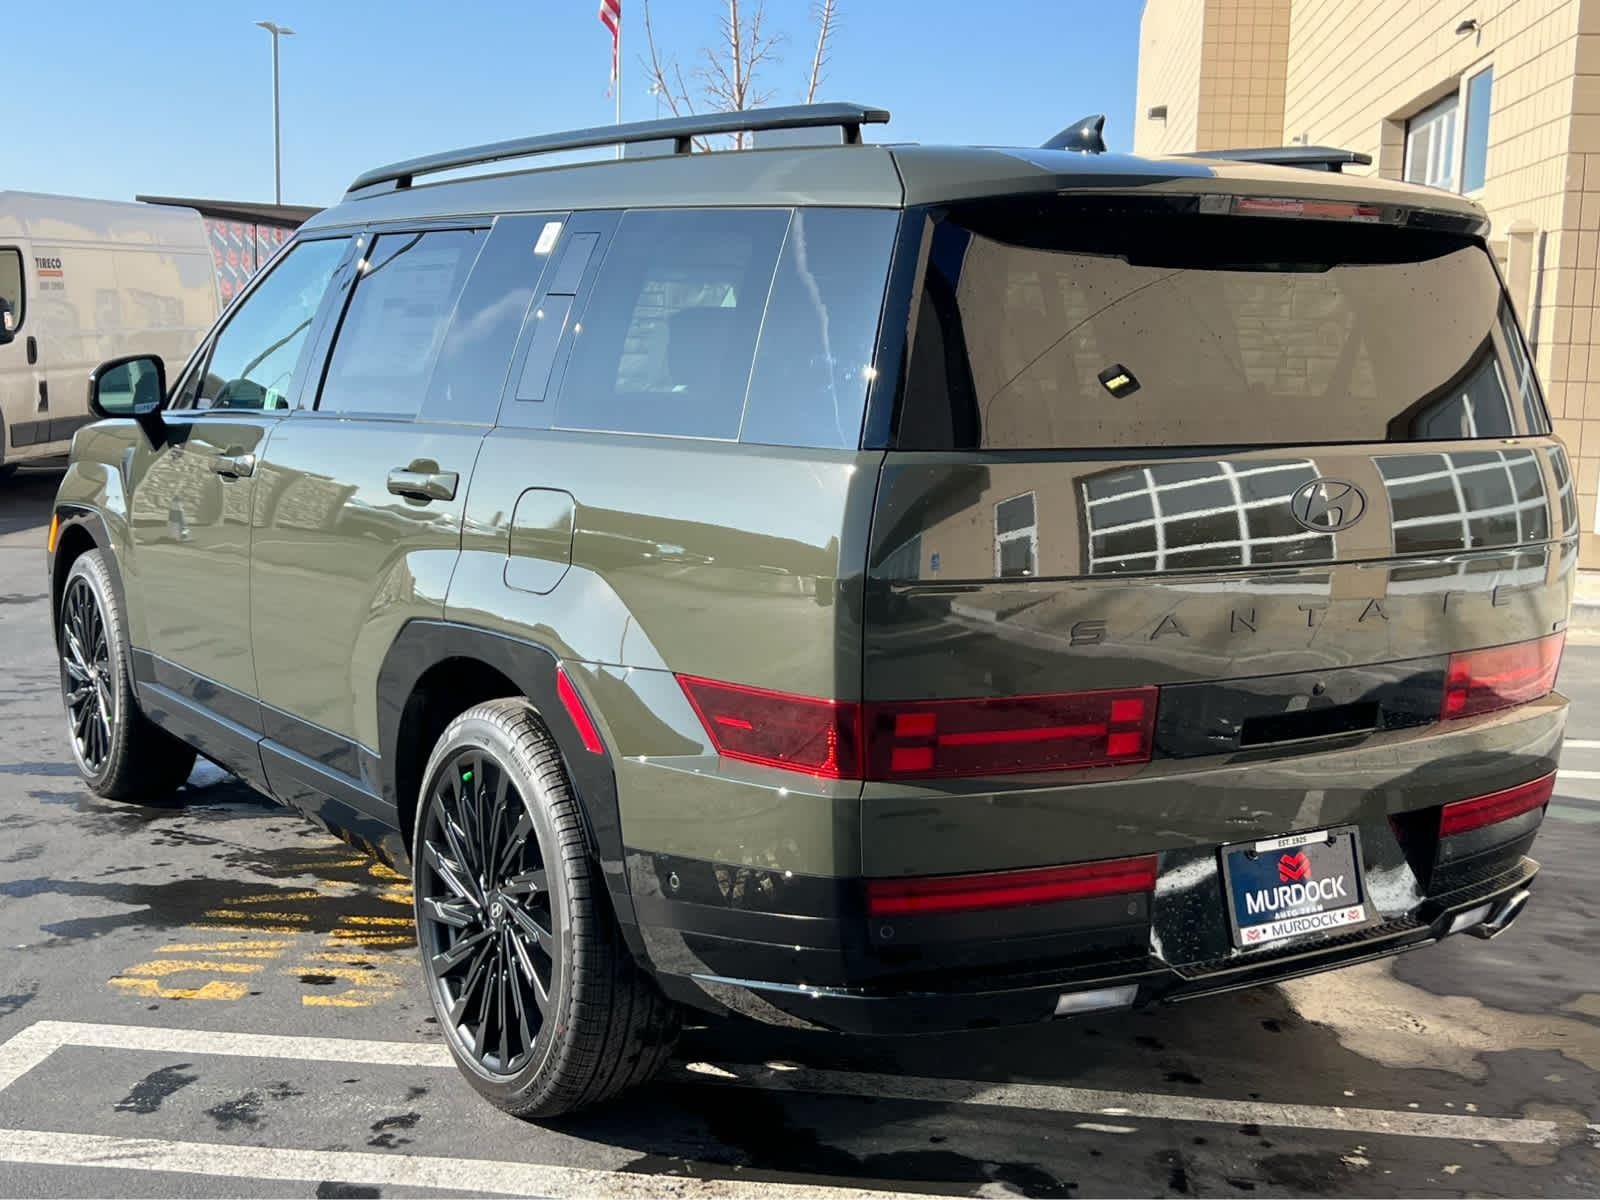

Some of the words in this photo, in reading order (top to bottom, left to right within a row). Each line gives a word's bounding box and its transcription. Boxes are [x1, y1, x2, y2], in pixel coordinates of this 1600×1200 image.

[34, 257, 62, 269] TIRECO
[1069, 598, 1390, 647] SANTA
[1245, 875, 1347, 915] MURDOCK
[1271, 912, 1340, 937] MURDOCK
